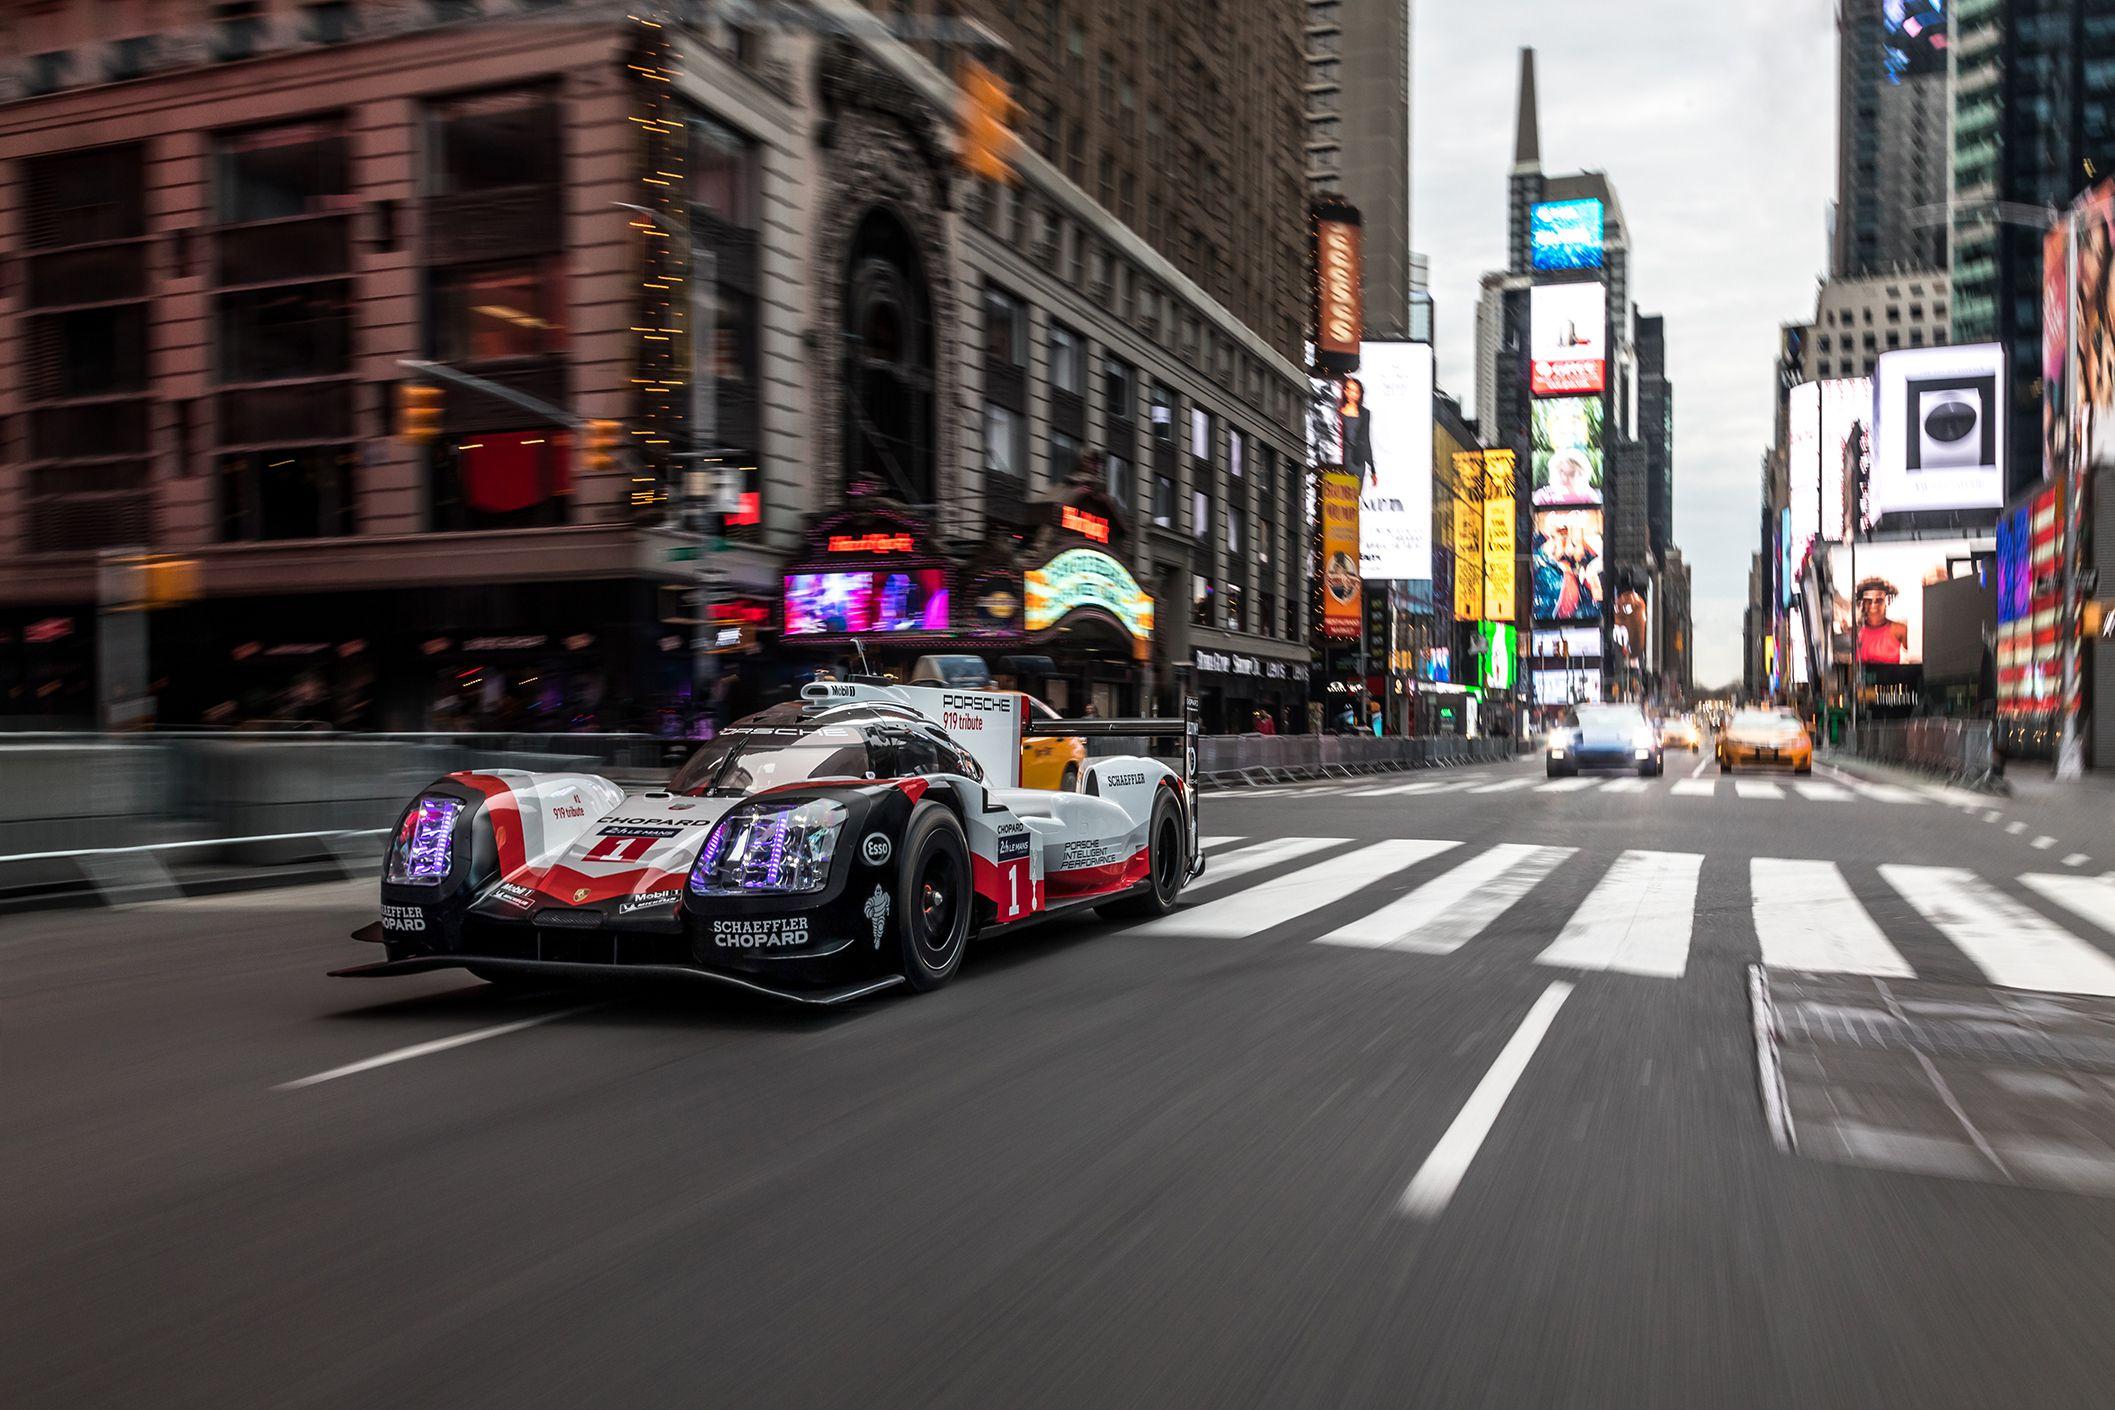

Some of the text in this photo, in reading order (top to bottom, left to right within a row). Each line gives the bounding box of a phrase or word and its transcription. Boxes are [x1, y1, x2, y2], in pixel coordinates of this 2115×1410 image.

[943, 695, 1010, 713] PORSCHE
[943, 712, 983, 731] 919 tribute
[718, 727, 849, 737] ORSCHE
[1107, 773, 1146, 788] SCHAEFFLER
[552, 806, 585, 820] 919 tribute
[597, 816, 710, 827] CHOPARD
[997, 822, 1024, 835] CHOPARD
[600, 838, 637, 861] 1
[867, 841, 888, 856] Esso
[1064, 839, 1099, 852] PORSCHE
[1062, 846, 1108, 861] INTELLIGENT
[1060, 854, 1116, 870] PERFORMANCE
[634, 890, 669, 902] Mobil
[1008, 864, 1020, 917] 1
[382, 917, 426, 931] OPARD
[713, 917, 809, 934] SCHAEFFLER
[715, 930, 809, 948] CHOPARD
